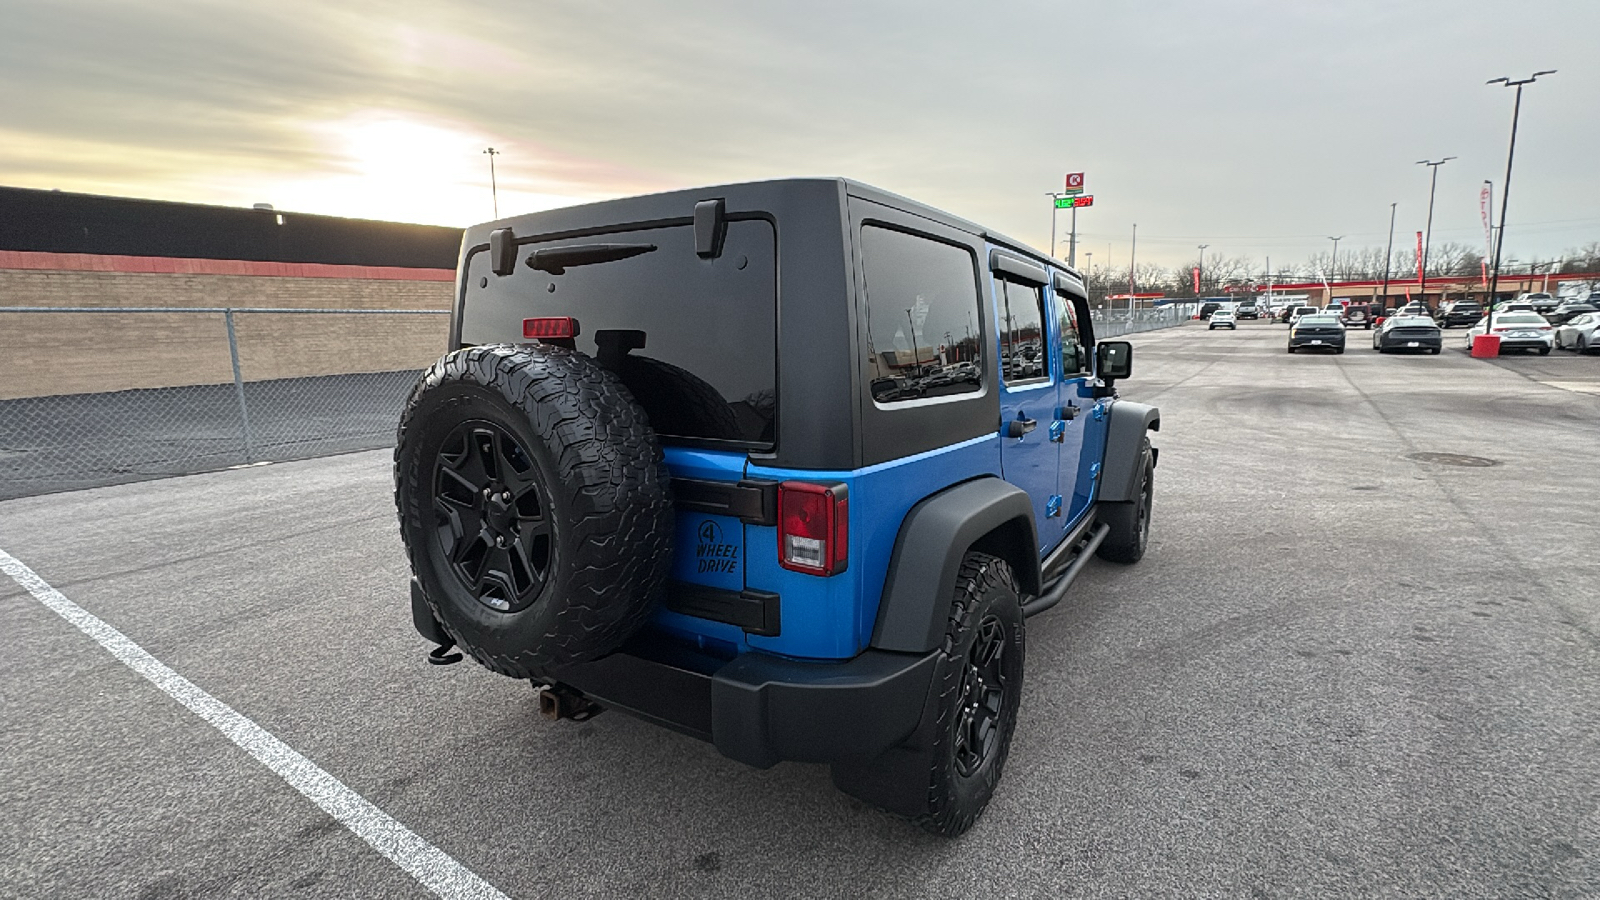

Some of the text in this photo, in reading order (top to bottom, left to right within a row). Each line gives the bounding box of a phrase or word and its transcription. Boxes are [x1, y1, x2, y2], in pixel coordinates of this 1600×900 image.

[702, 523, 715, 542] 4
[697, 544, 738, 558] WHEEL
[697, 559, 737, 573] DRIVE
